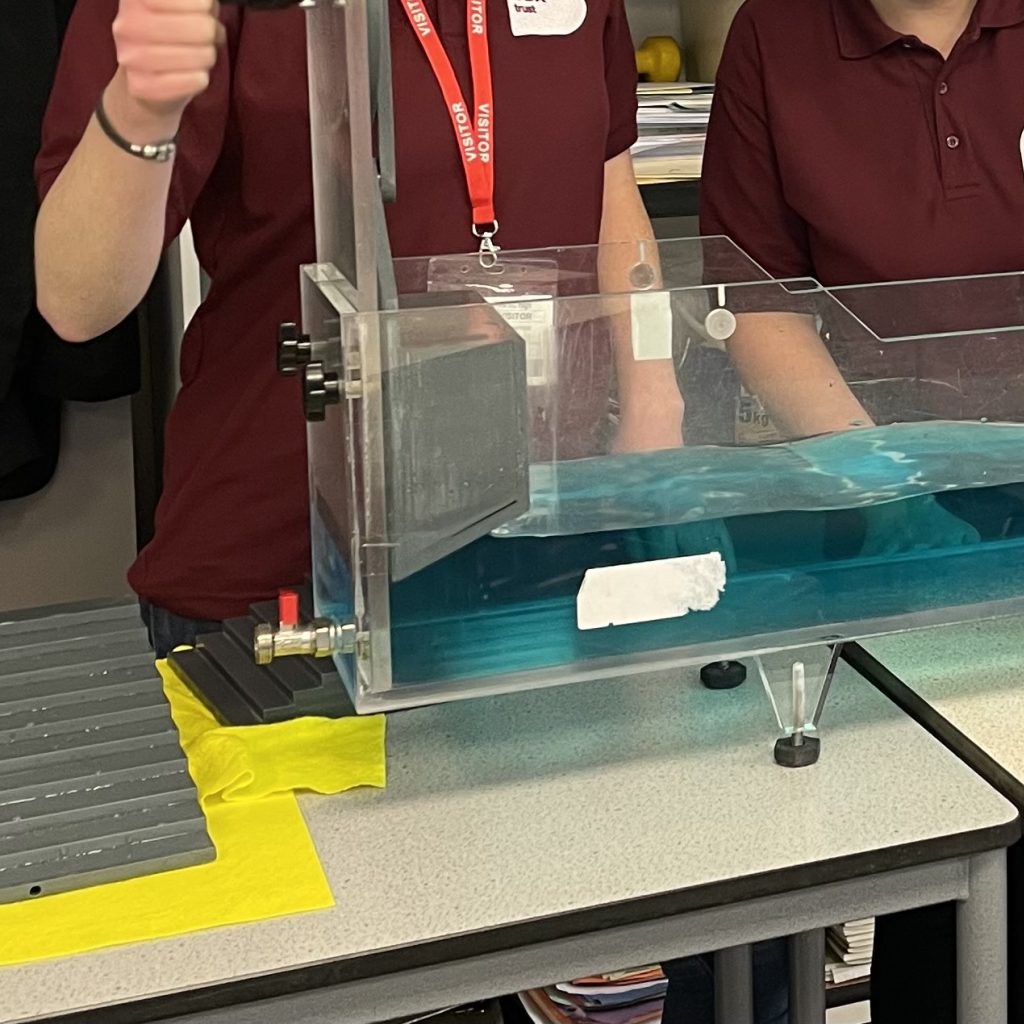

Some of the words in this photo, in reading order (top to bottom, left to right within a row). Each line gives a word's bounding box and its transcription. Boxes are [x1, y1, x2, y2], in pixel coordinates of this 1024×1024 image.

[514, 3, 538, 14] trust
[452, 102, 477, 163] VISITOR
[478, 103, 490, 164] VISITOR
